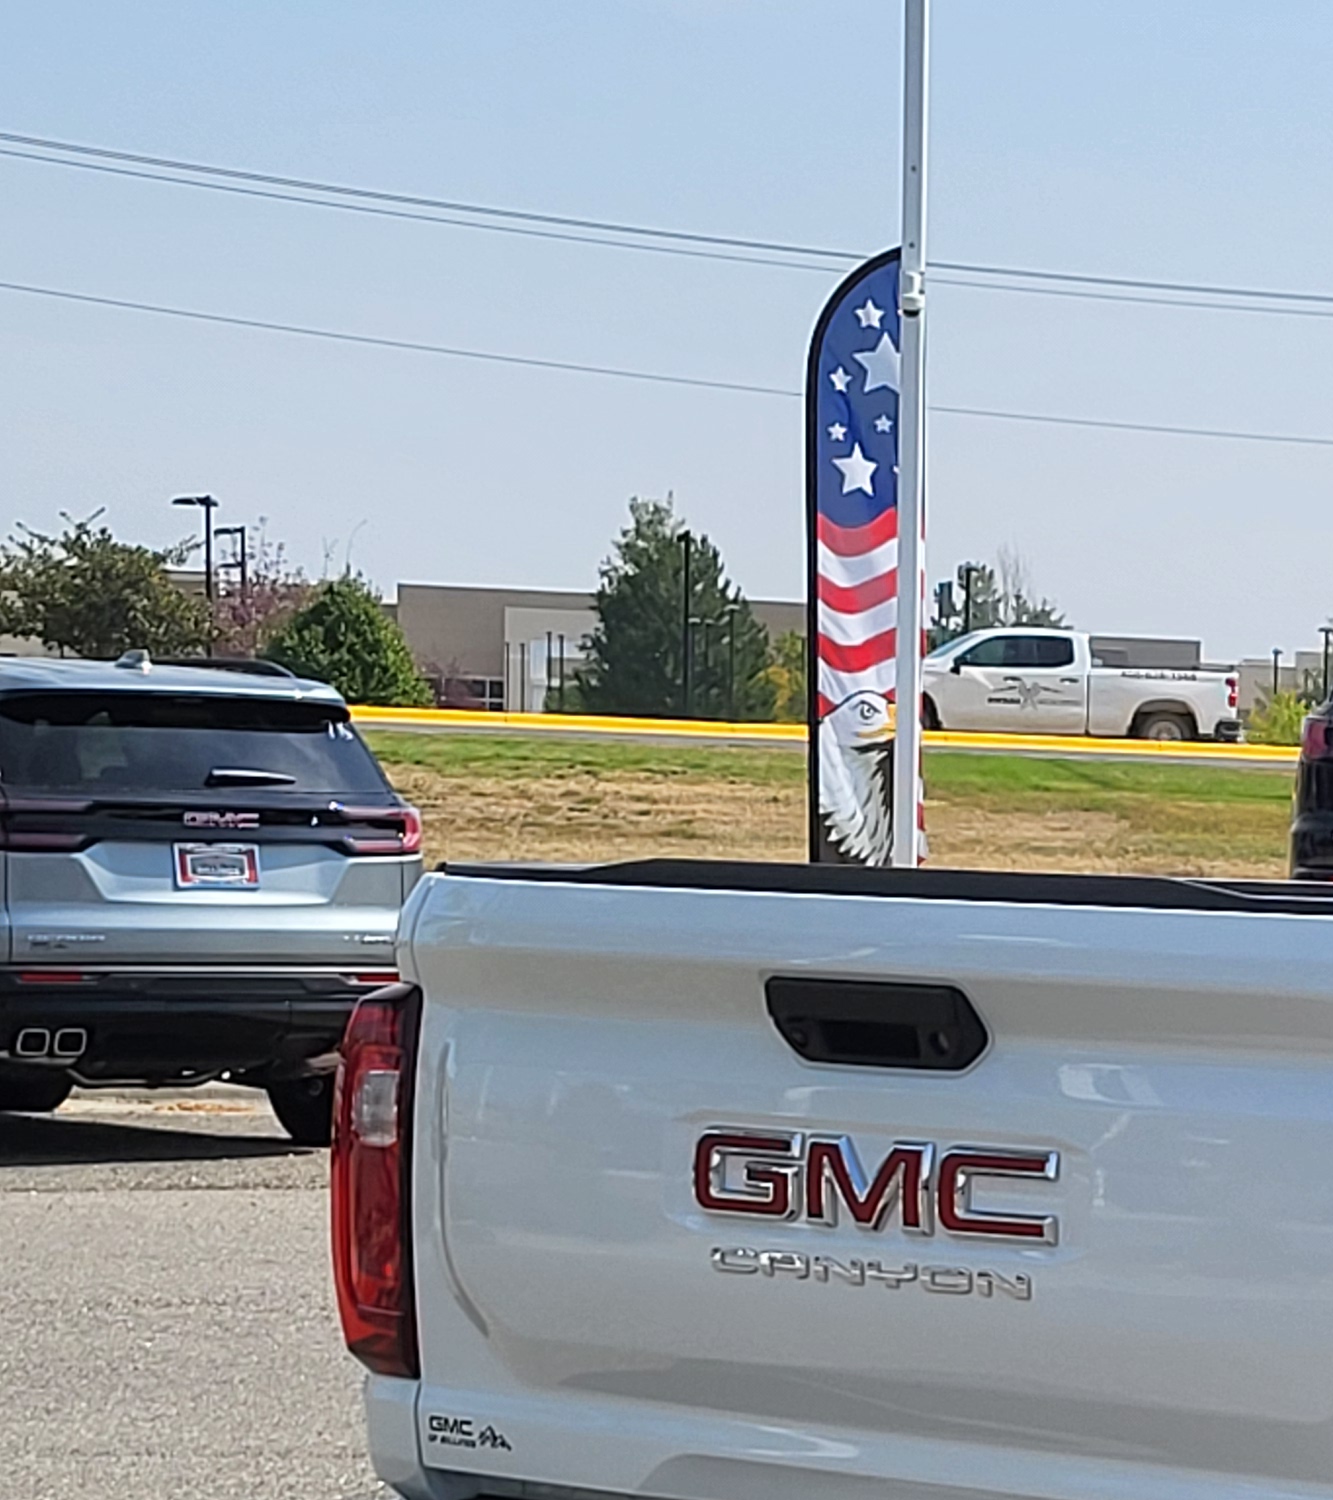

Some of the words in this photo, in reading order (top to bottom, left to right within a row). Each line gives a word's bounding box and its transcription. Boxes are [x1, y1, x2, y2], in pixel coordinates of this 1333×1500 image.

[183, 811, 260, 829] GMC
[694, 1125, 1059, 1246] GMC
[711, 1246, 1032, 1301] CANYON
[428, 1415, 474, 1436] GMC
